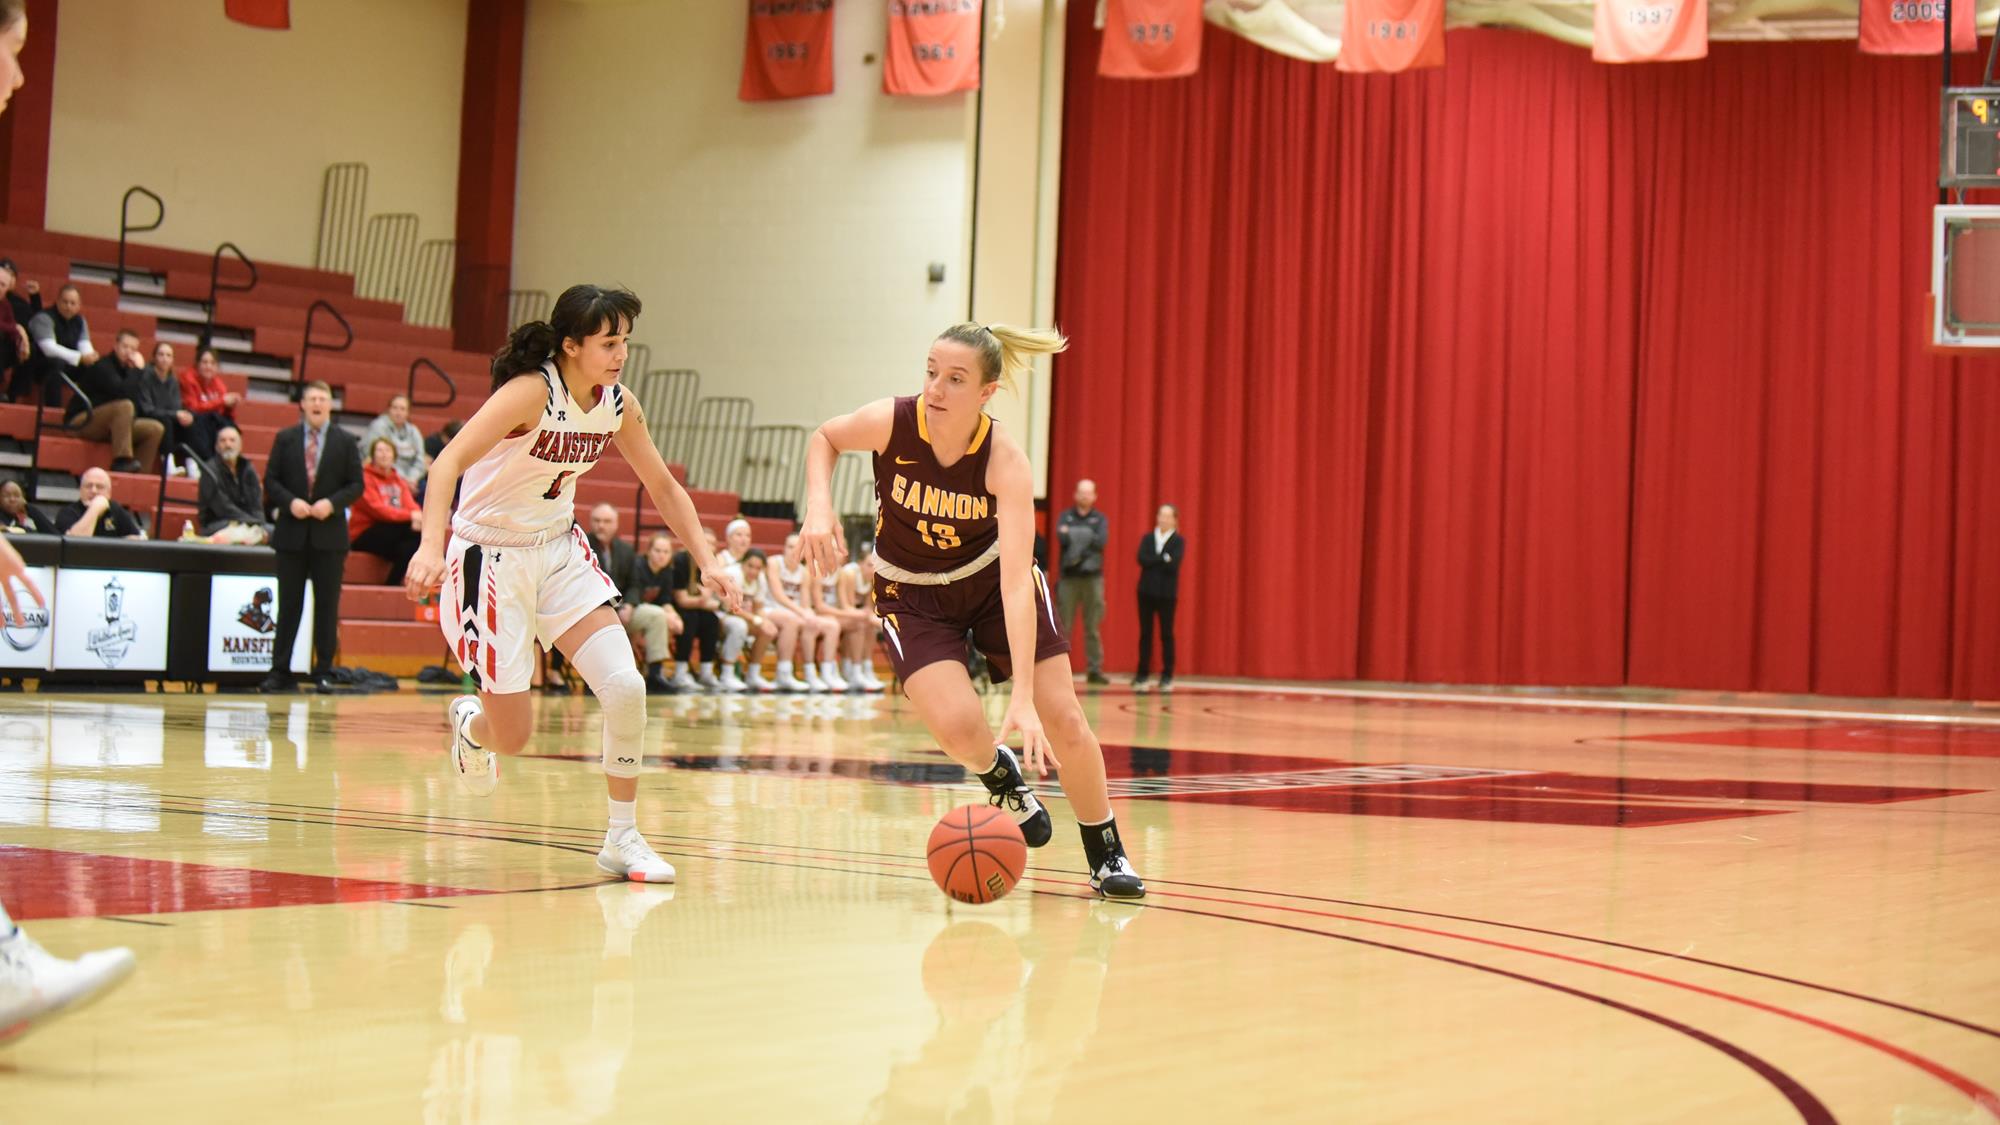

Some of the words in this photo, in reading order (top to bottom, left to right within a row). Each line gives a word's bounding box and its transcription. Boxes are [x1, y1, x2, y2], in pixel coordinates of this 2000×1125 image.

[891, 473, 988, 520] GANNON
[916, 519, 962, 550] 13
[1, 611, 46, 624] NISAN
